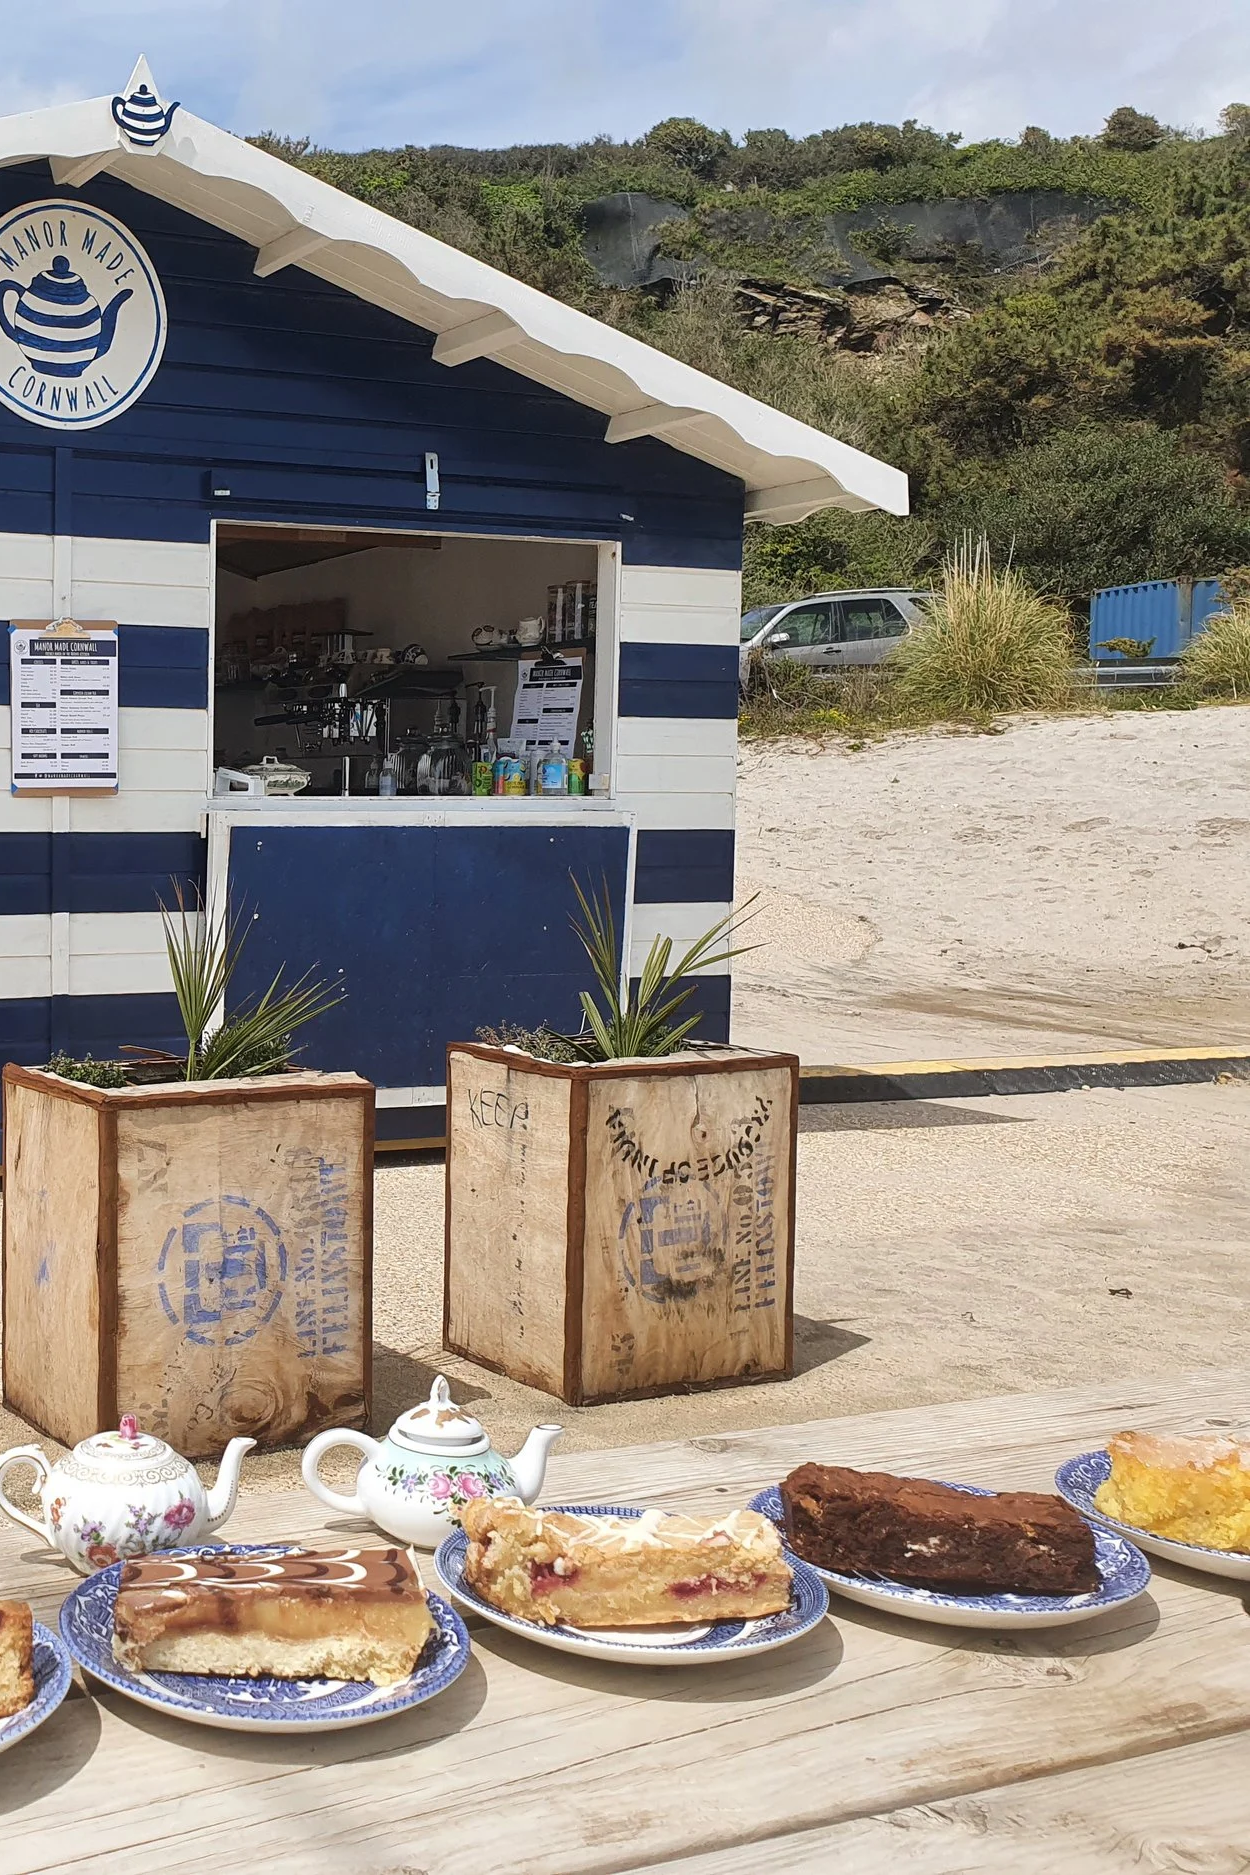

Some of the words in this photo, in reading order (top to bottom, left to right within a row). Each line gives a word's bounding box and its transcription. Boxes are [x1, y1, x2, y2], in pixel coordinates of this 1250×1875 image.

[82, 227, 135, 285] MADE
[8, 366, 119, 412] CORNWALL
[34, 642, 53, 652] MANOR
[54, 642, 69, 652] MADE
[467, 1088, 529, 1131] KEEP
